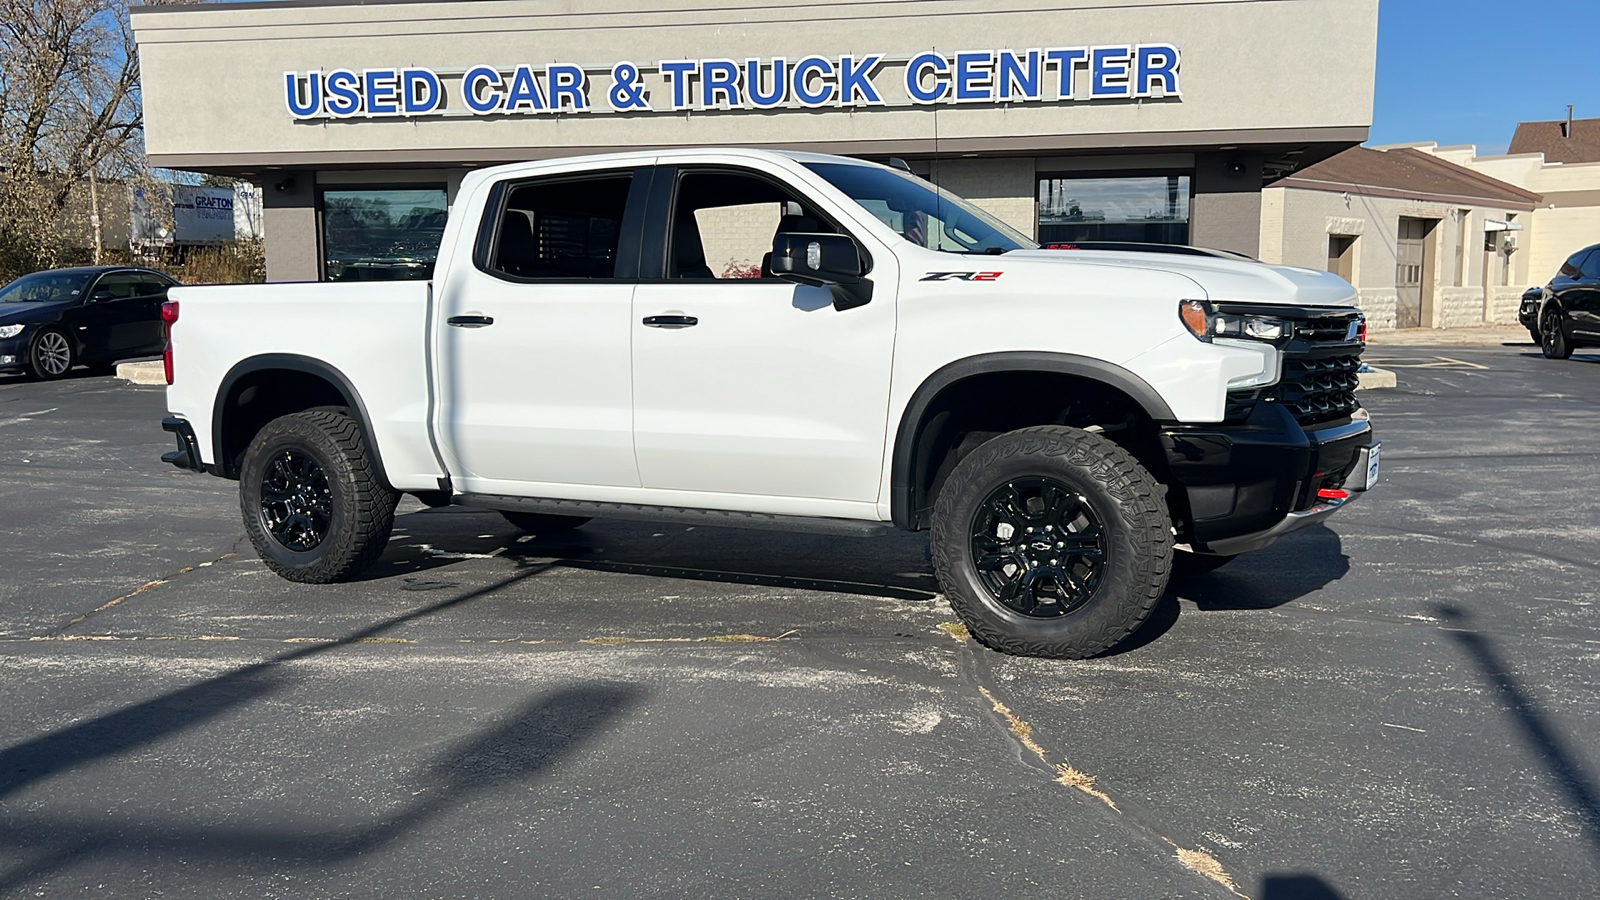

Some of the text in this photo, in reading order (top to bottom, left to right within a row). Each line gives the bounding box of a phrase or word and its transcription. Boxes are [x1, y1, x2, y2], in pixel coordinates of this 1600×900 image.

[285, 44, 1180, 118] USED CAR & TRUCK CENTER
[195, 196, 233, 208] GRAFTON
[918, 271, 1004, 282] ZR2
